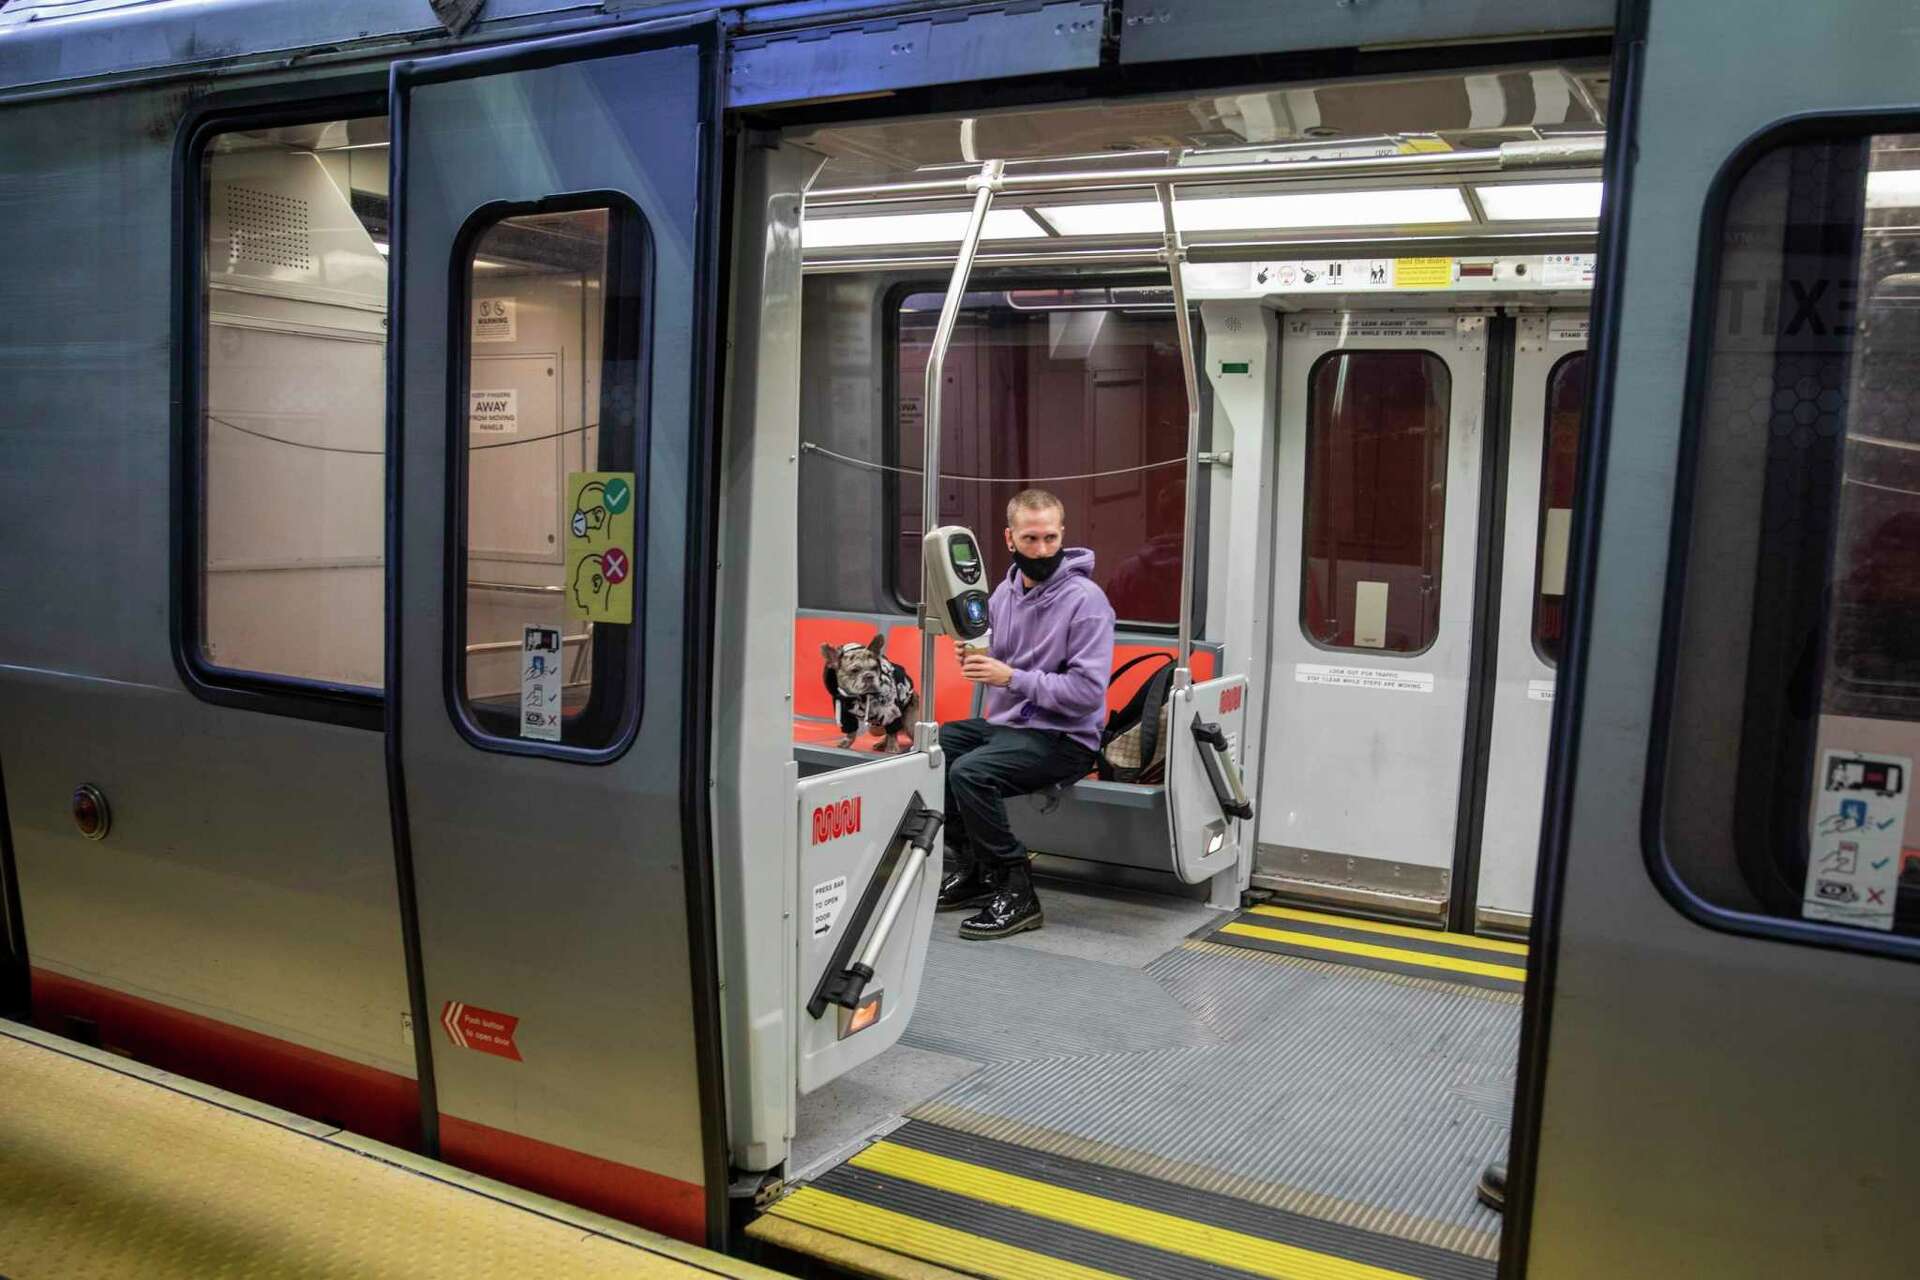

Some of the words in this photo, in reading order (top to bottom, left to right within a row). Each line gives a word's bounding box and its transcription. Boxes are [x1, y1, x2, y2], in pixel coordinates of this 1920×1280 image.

[475, 401, 507, 411] AWAY
[815, 884, 832, 894] PRESS
[833, 880, 844, 889] BAR
[824, 896, 839, 906] OPEN
[815, 912, 831, 923] DOOR
[482, 1019, 505, 1031] button
